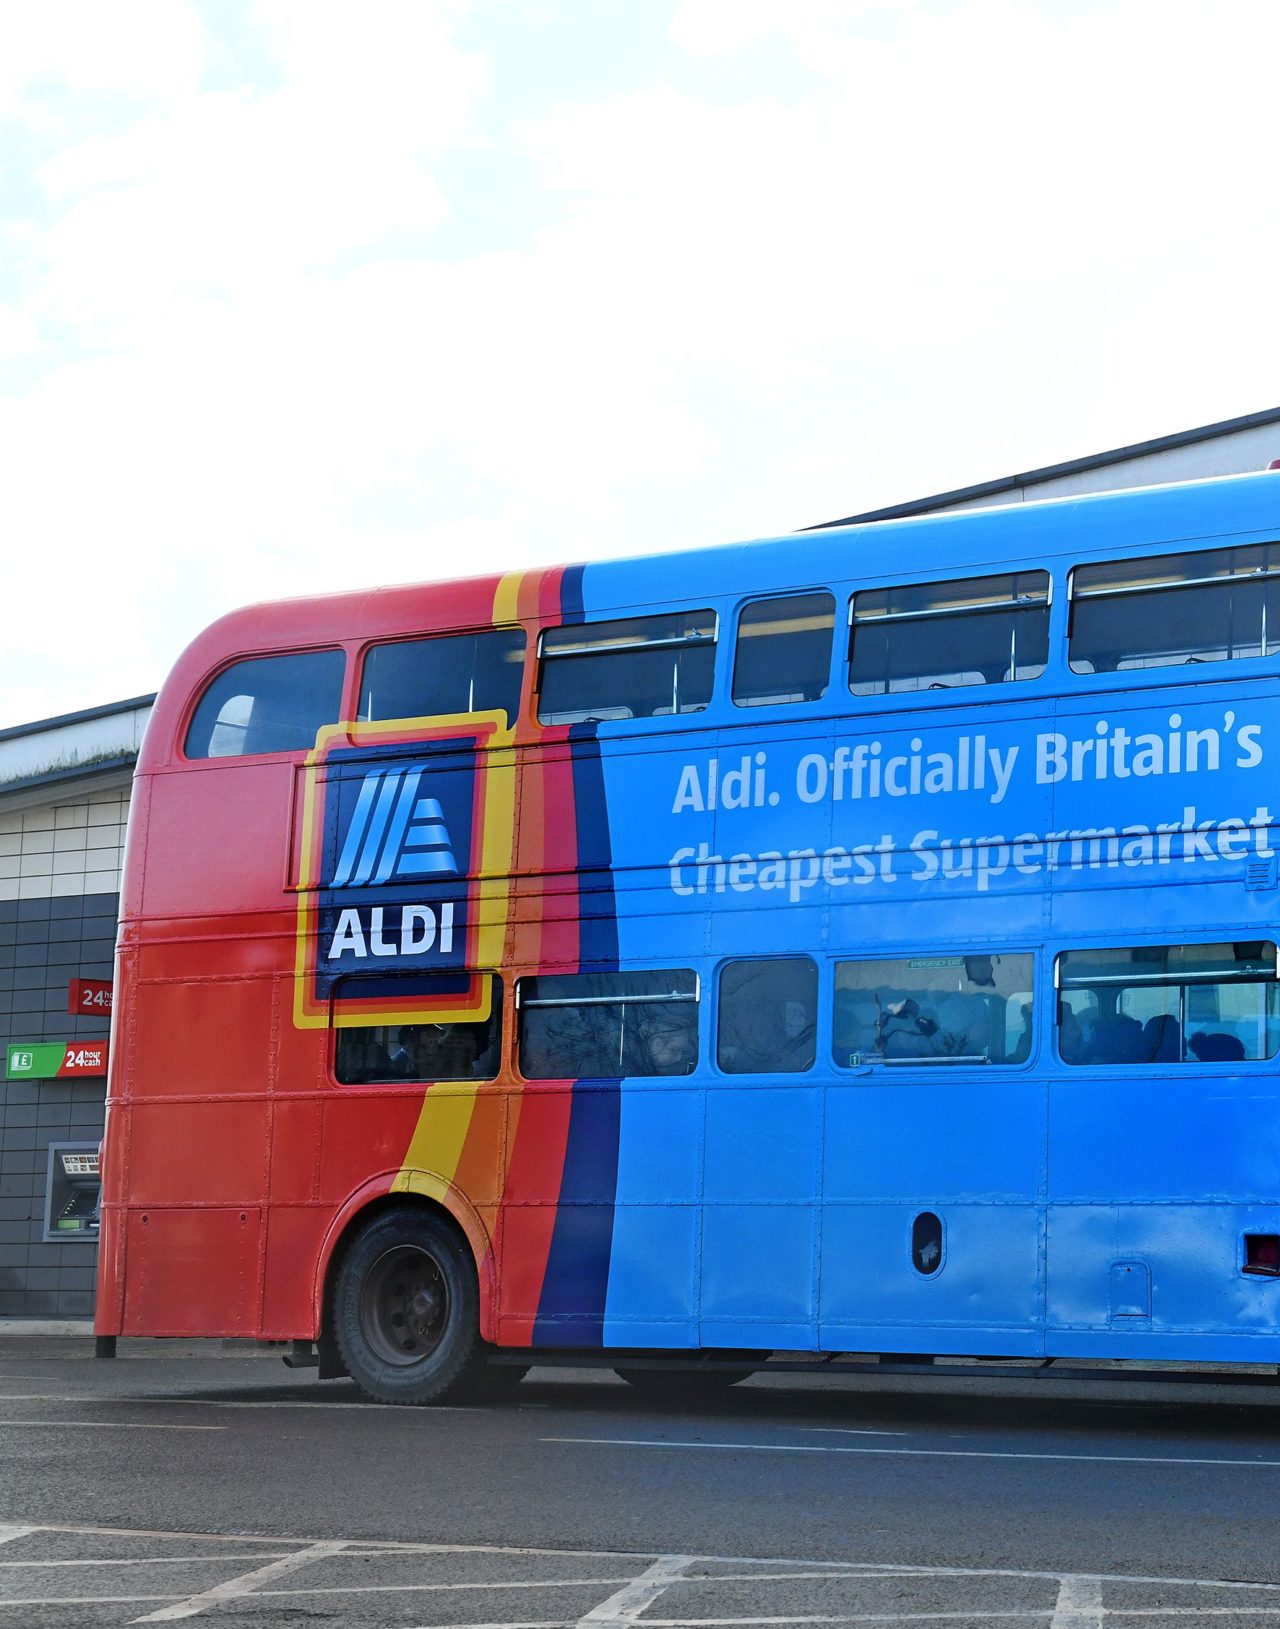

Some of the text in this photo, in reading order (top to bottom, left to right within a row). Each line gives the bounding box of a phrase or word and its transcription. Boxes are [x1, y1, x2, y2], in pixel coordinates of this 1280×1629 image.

[671, 711, 1263, 813] Aldi. Officially Britain’s
[669, 806, 1274, 903] Cheapest Supermarket
[327, 902, 455, 959] ALDI
[82, 989, 113, 1006] 24 ho
[104, 999, 113, 1007] ca
[66, 1050, 101, 1067] 24 hour
[84, 1058, 101, 1066] cash
